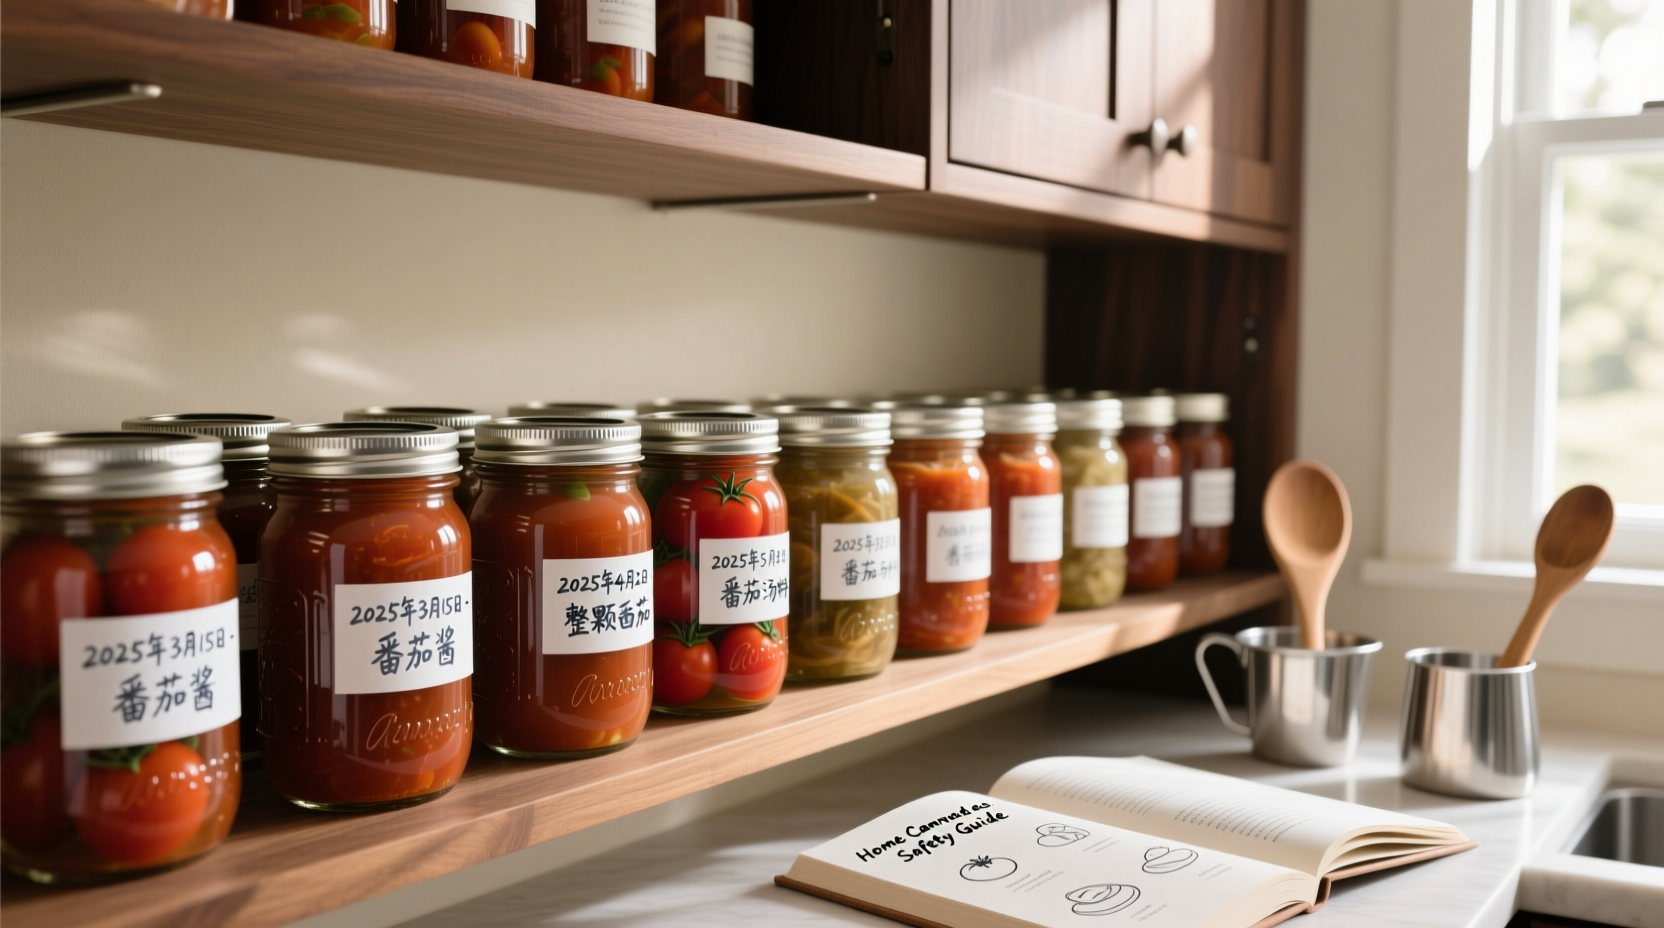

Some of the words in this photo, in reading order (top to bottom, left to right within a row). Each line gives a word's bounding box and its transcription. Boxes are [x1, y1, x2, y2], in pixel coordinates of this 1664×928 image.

[564, 596, 650, 638] 整颗番茄
[371, 625, 456, 676] 番茄酱
[112, 664, 215, 725] 番茄酱
[855, 835, 907, 863] Home
[897, 832, 955, 863] Safety
[955, 811, 1010, 835] Guide
